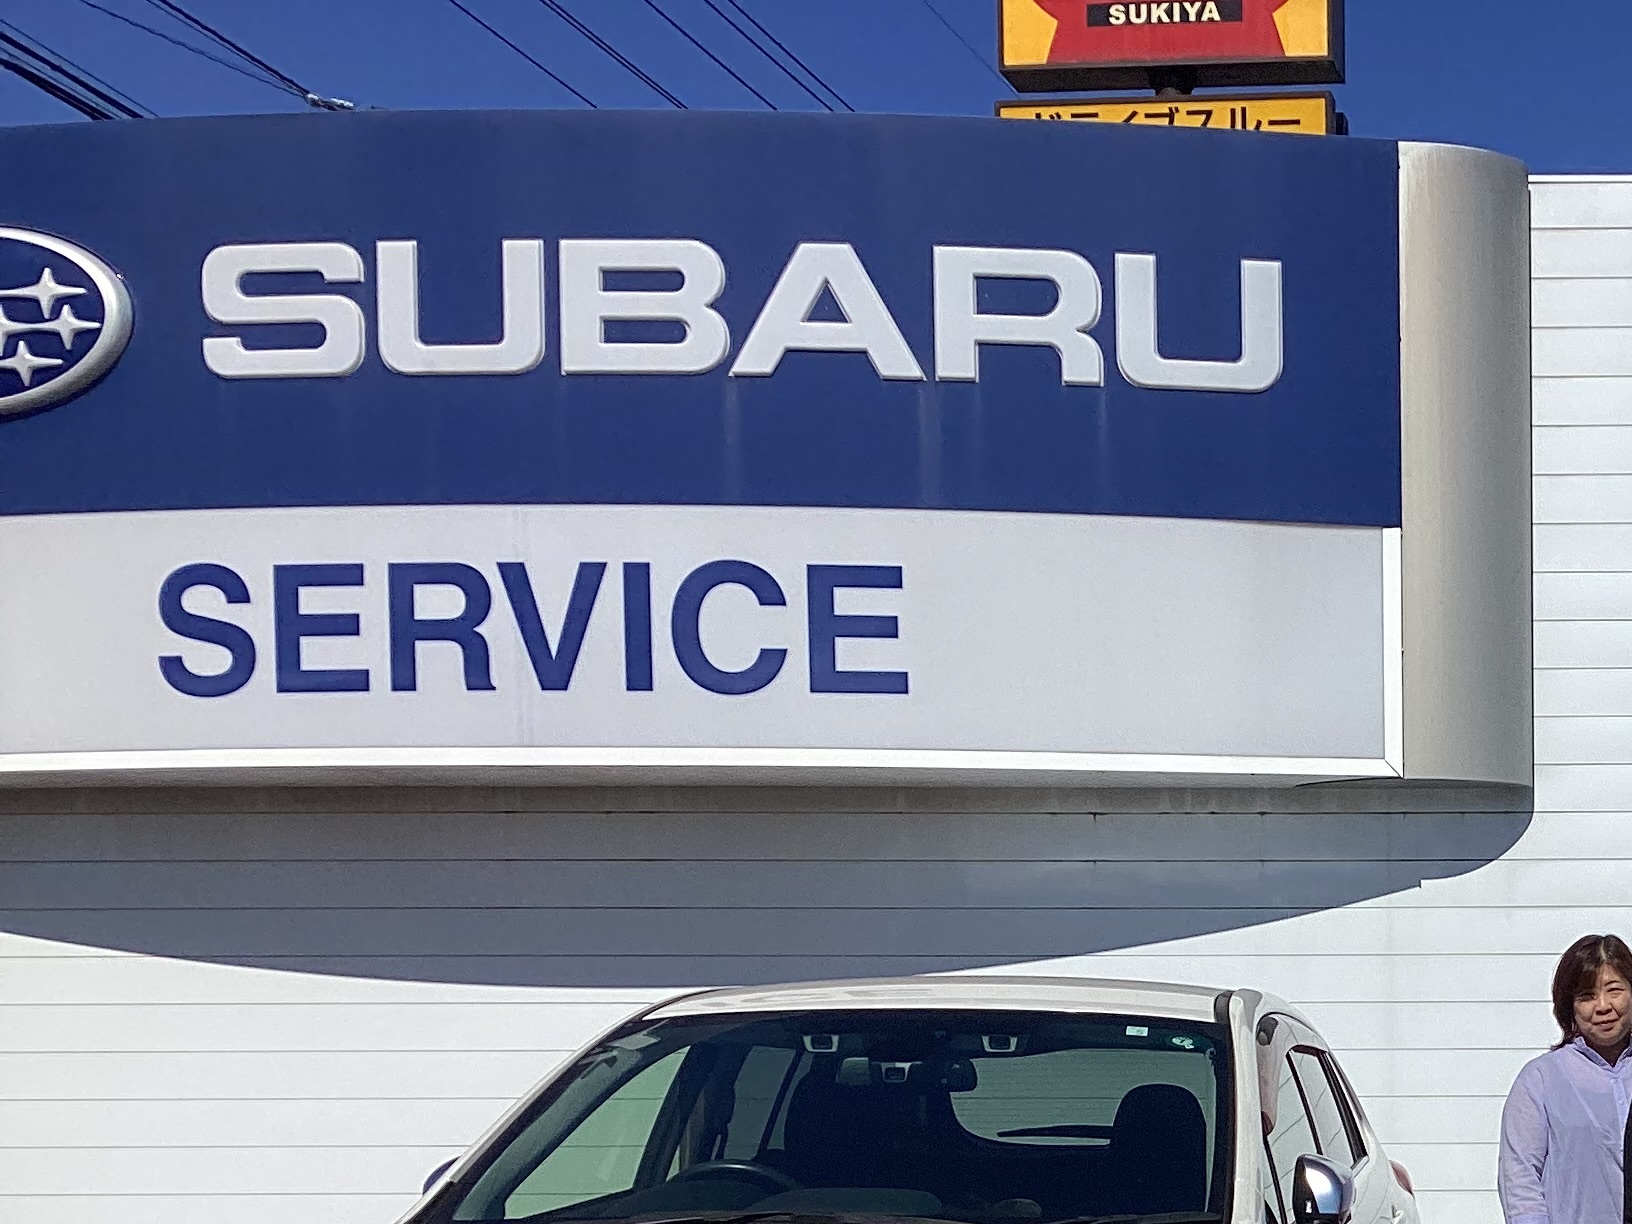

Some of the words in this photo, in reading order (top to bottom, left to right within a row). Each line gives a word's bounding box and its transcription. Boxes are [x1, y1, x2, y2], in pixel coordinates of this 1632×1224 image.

[1108, 1, 1221, 25] SUKIYA
[201, 238, 1283, 393] SUBARU
[158, 559, 909, 698] SERVICE
